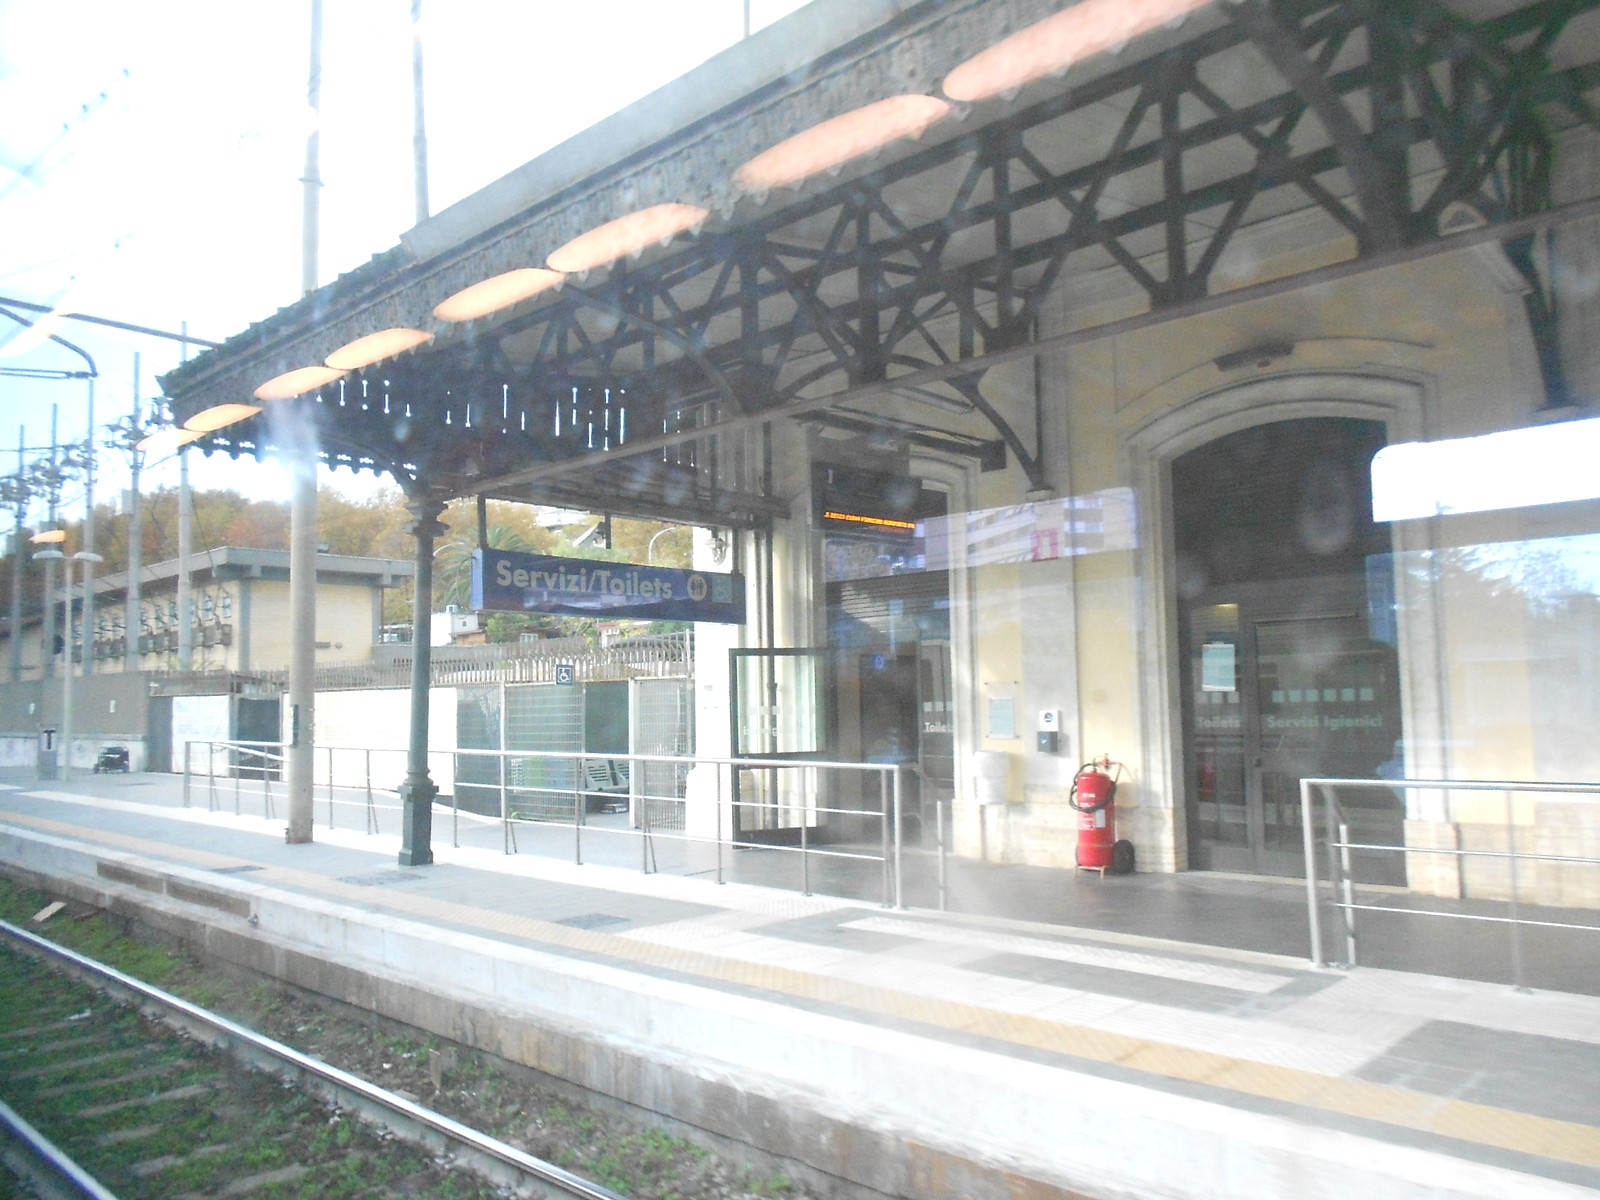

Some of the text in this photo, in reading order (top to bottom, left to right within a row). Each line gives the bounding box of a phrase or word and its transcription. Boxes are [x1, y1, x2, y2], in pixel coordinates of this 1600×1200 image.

[495, 558, 673, 600] Servizi/Toilets
[923, 720, 953, 733] Toilet
[1266, 713, 1383, 731] Servizi Igienici
